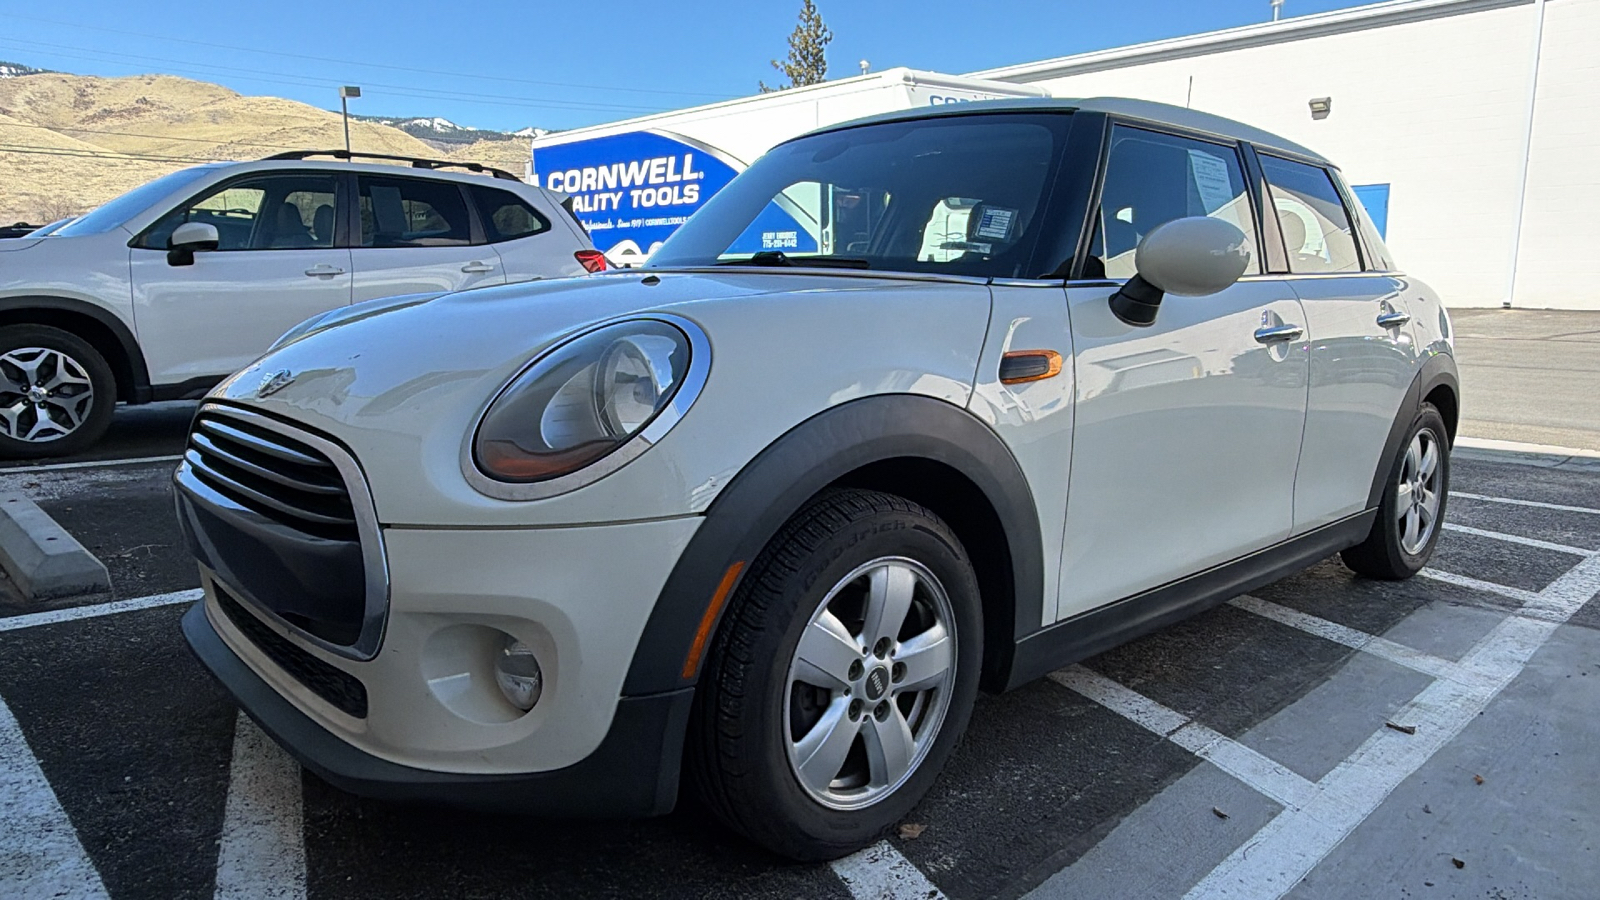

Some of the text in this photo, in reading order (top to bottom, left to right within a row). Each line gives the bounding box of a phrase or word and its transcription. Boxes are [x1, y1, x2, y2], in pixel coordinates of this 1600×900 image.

[547, 154, 698, 192] CORNWELL
[572, 185, 699, 213] ALITY TOOLS
